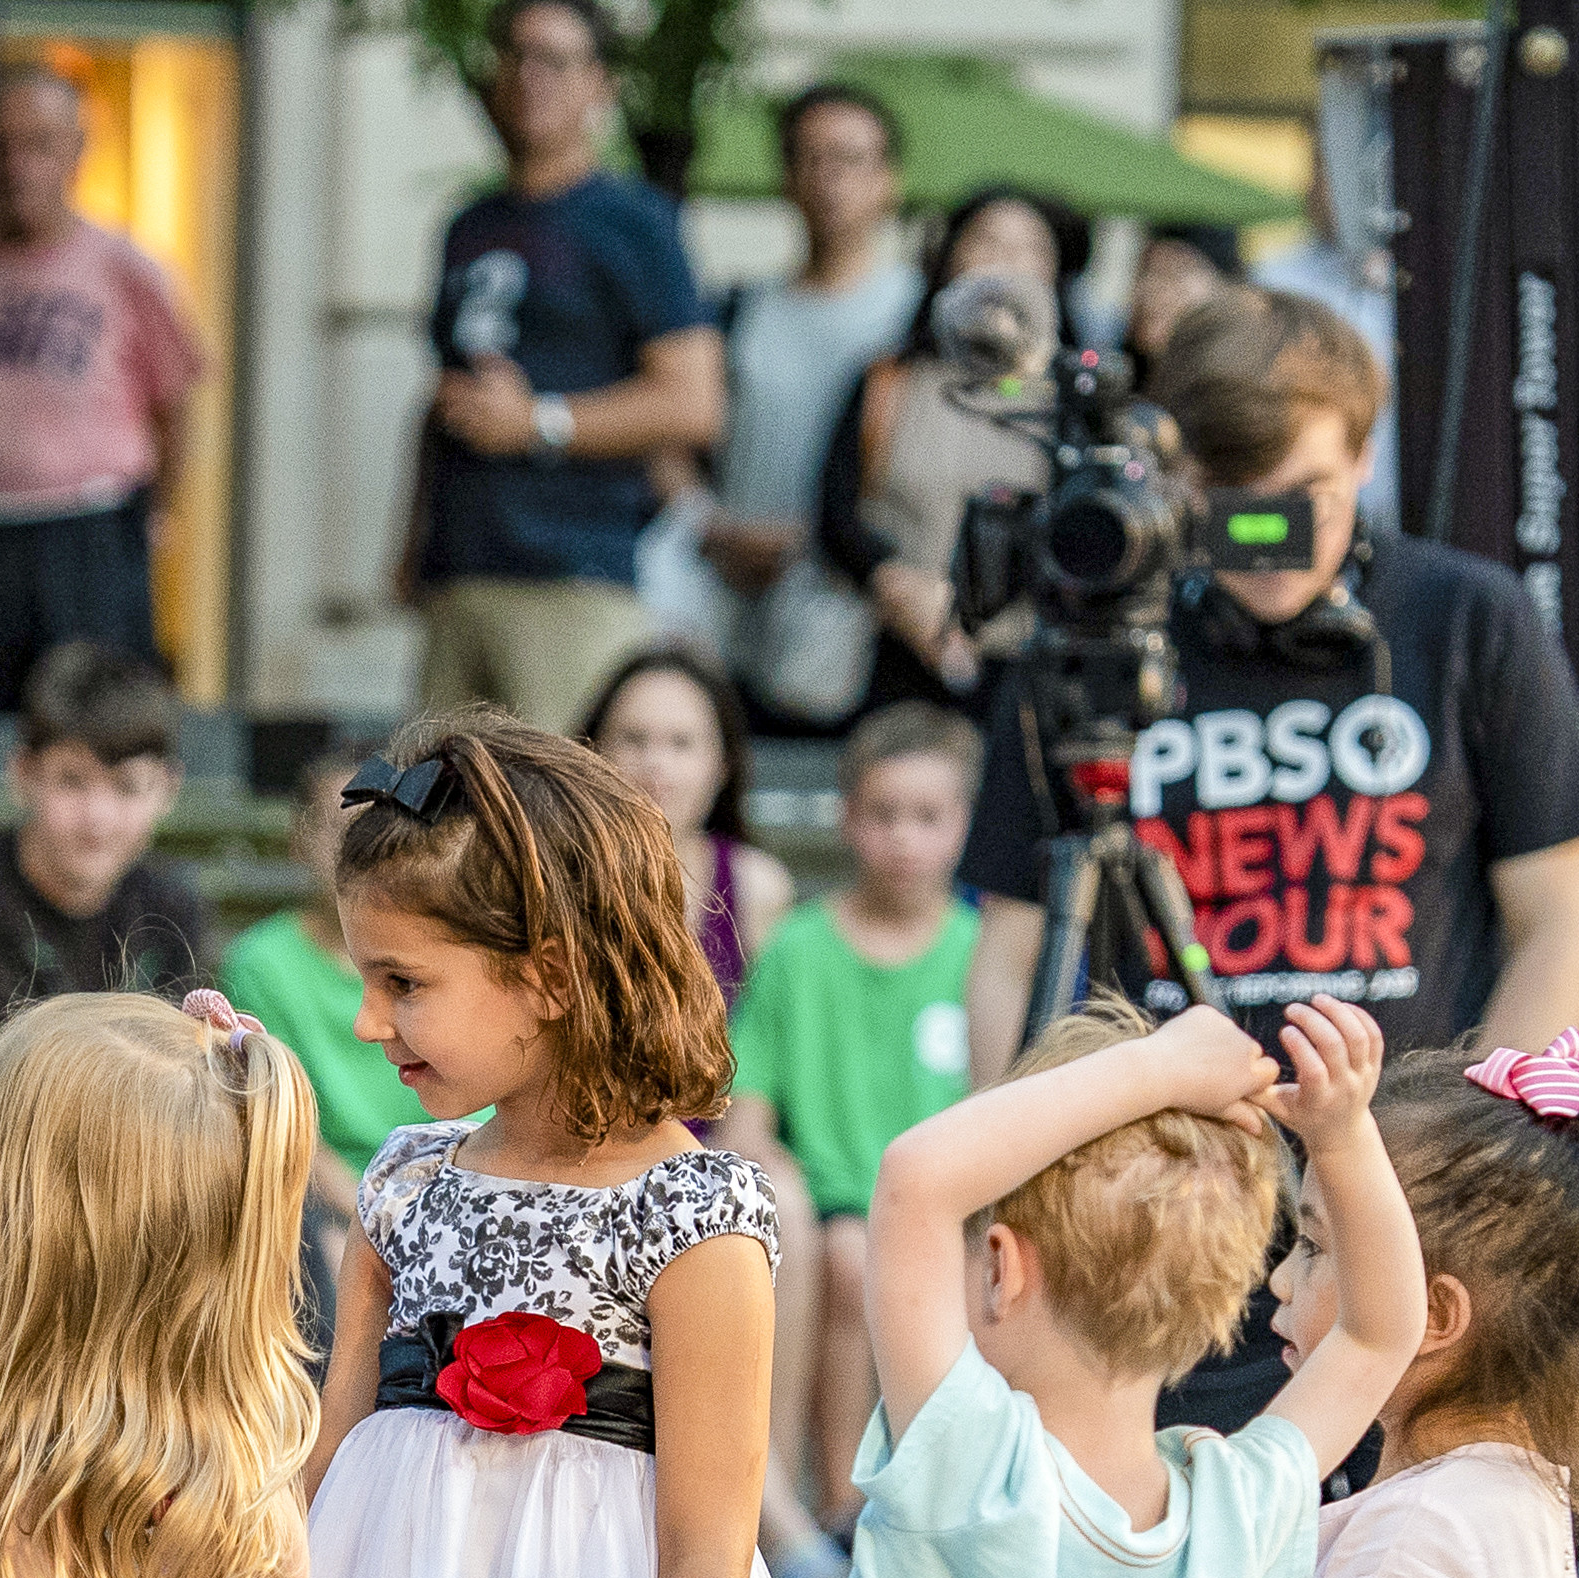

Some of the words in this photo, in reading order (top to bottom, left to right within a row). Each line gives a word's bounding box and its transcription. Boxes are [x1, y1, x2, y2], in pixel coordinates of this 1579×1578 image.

[1128, 699, 1334, 819] PBS
[1133, 792, 1429, 900] NEWS
[1144, 884, 1415, 976] OUR
